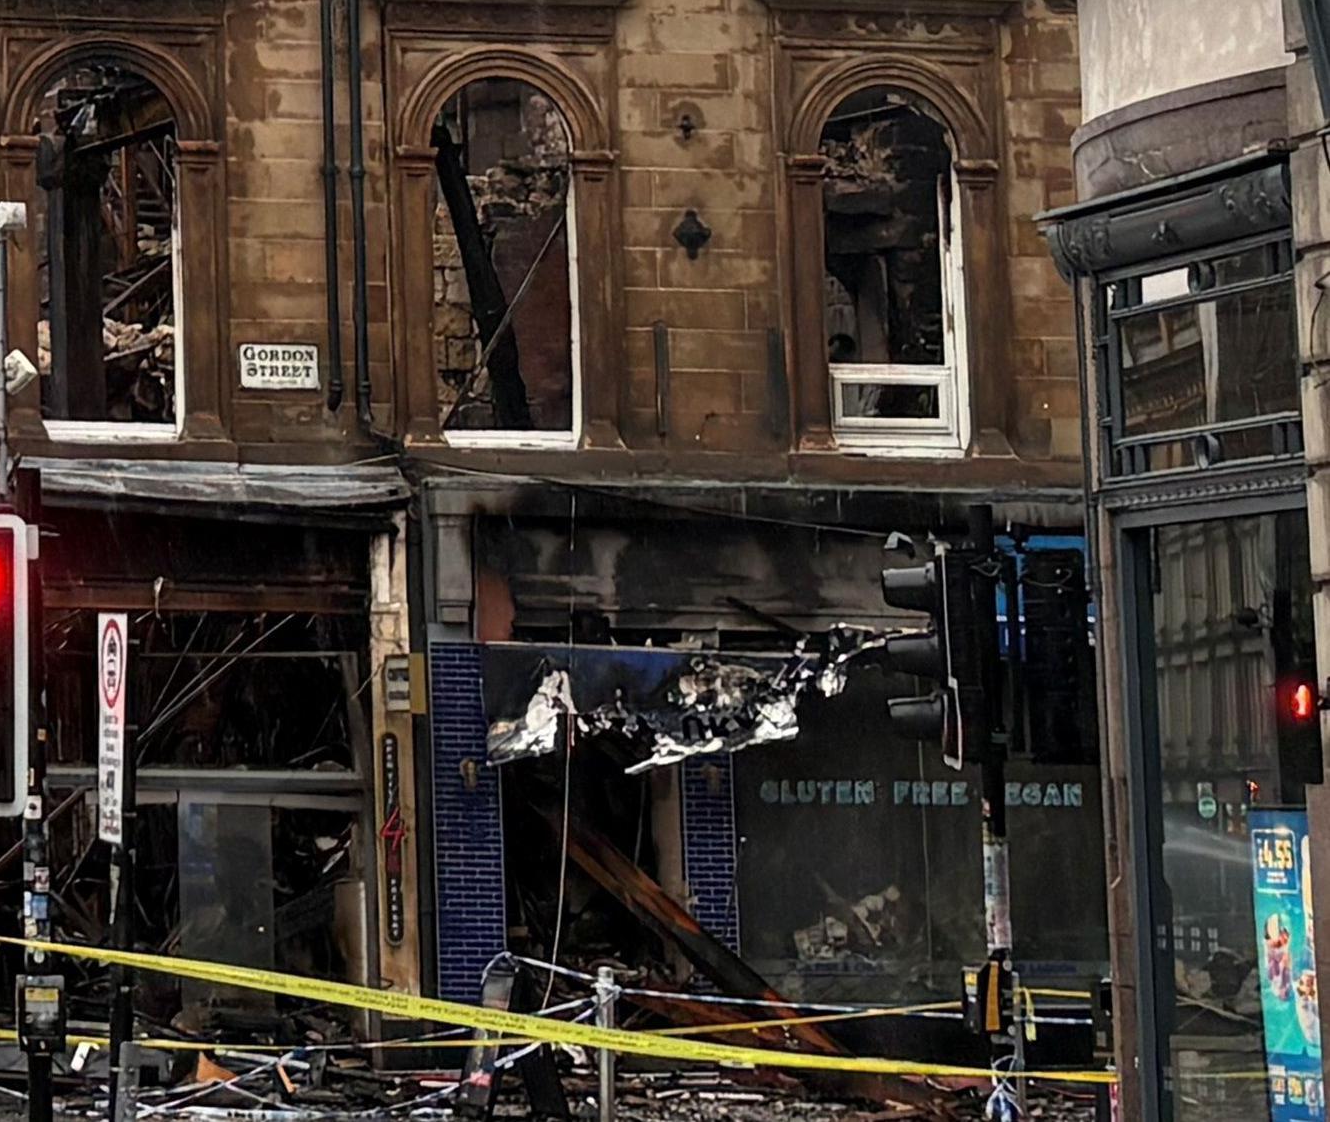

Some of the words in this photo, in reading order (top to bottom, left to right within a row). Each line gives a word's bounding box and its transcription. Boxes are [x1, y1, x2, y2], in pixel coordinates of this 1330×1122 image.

[243, 346, 314, 361] GORDON
[247, 362, 313, 378] STREET
[759, 779, 876, 805] GLUTEN
[893, 780, 969, 806] FREE
[1004, 781, 1083, 808] EGAN
